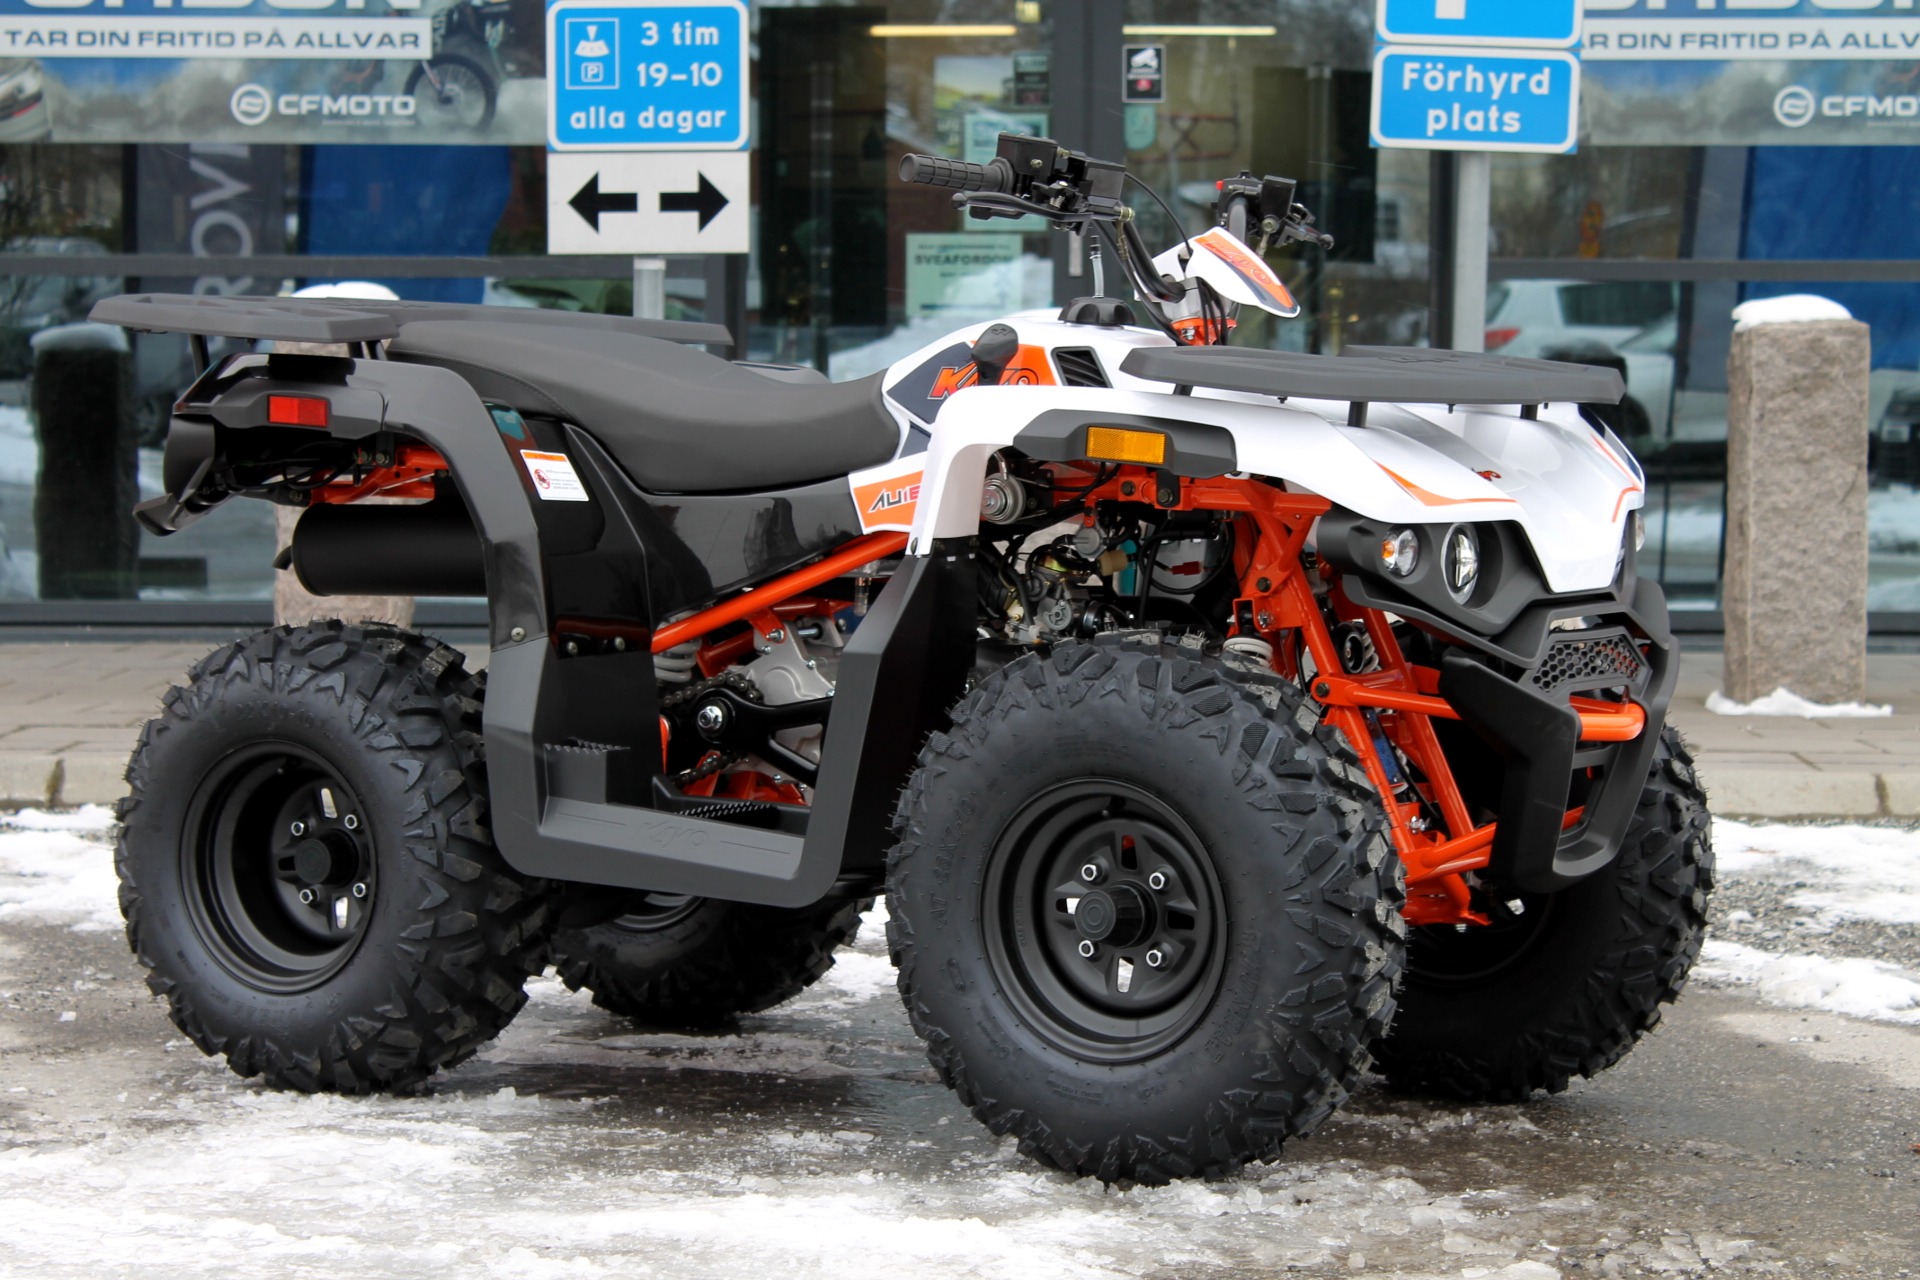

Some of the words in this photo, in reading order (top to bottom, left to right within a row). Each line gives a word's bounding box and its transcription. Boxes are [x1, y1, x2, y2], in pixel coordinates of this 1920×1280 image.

[4, 31, 68, 46] TAR
[77, 31, 130, 47] DIN
[138, 32, 235, 47] FRITID
[244, 28, 285, 48] PÅ
[295, 32, 420, 48] ALLVAR
[640, 21, 659, 46] 3
[672, 20, 719, 45] tim
[1617, 33, 1671, 49] DIN
[1680, 33, 1779, 49] FRITID
[1788, 28, 1832, 49] PÅ
[1840, 33, 1920, 48] ALLV
[637, 62, 723, 87] 19-10
[1402, 61, 1551, 101] Förhyrd
[278, 94, 416, 116] CFMOTO
[1822, 96, 1920, 117] CFMO
[570, 106, 625, 129] alla
[638, 105, 727, 134] dagar
[1426, 102, 1521, 137] plats
